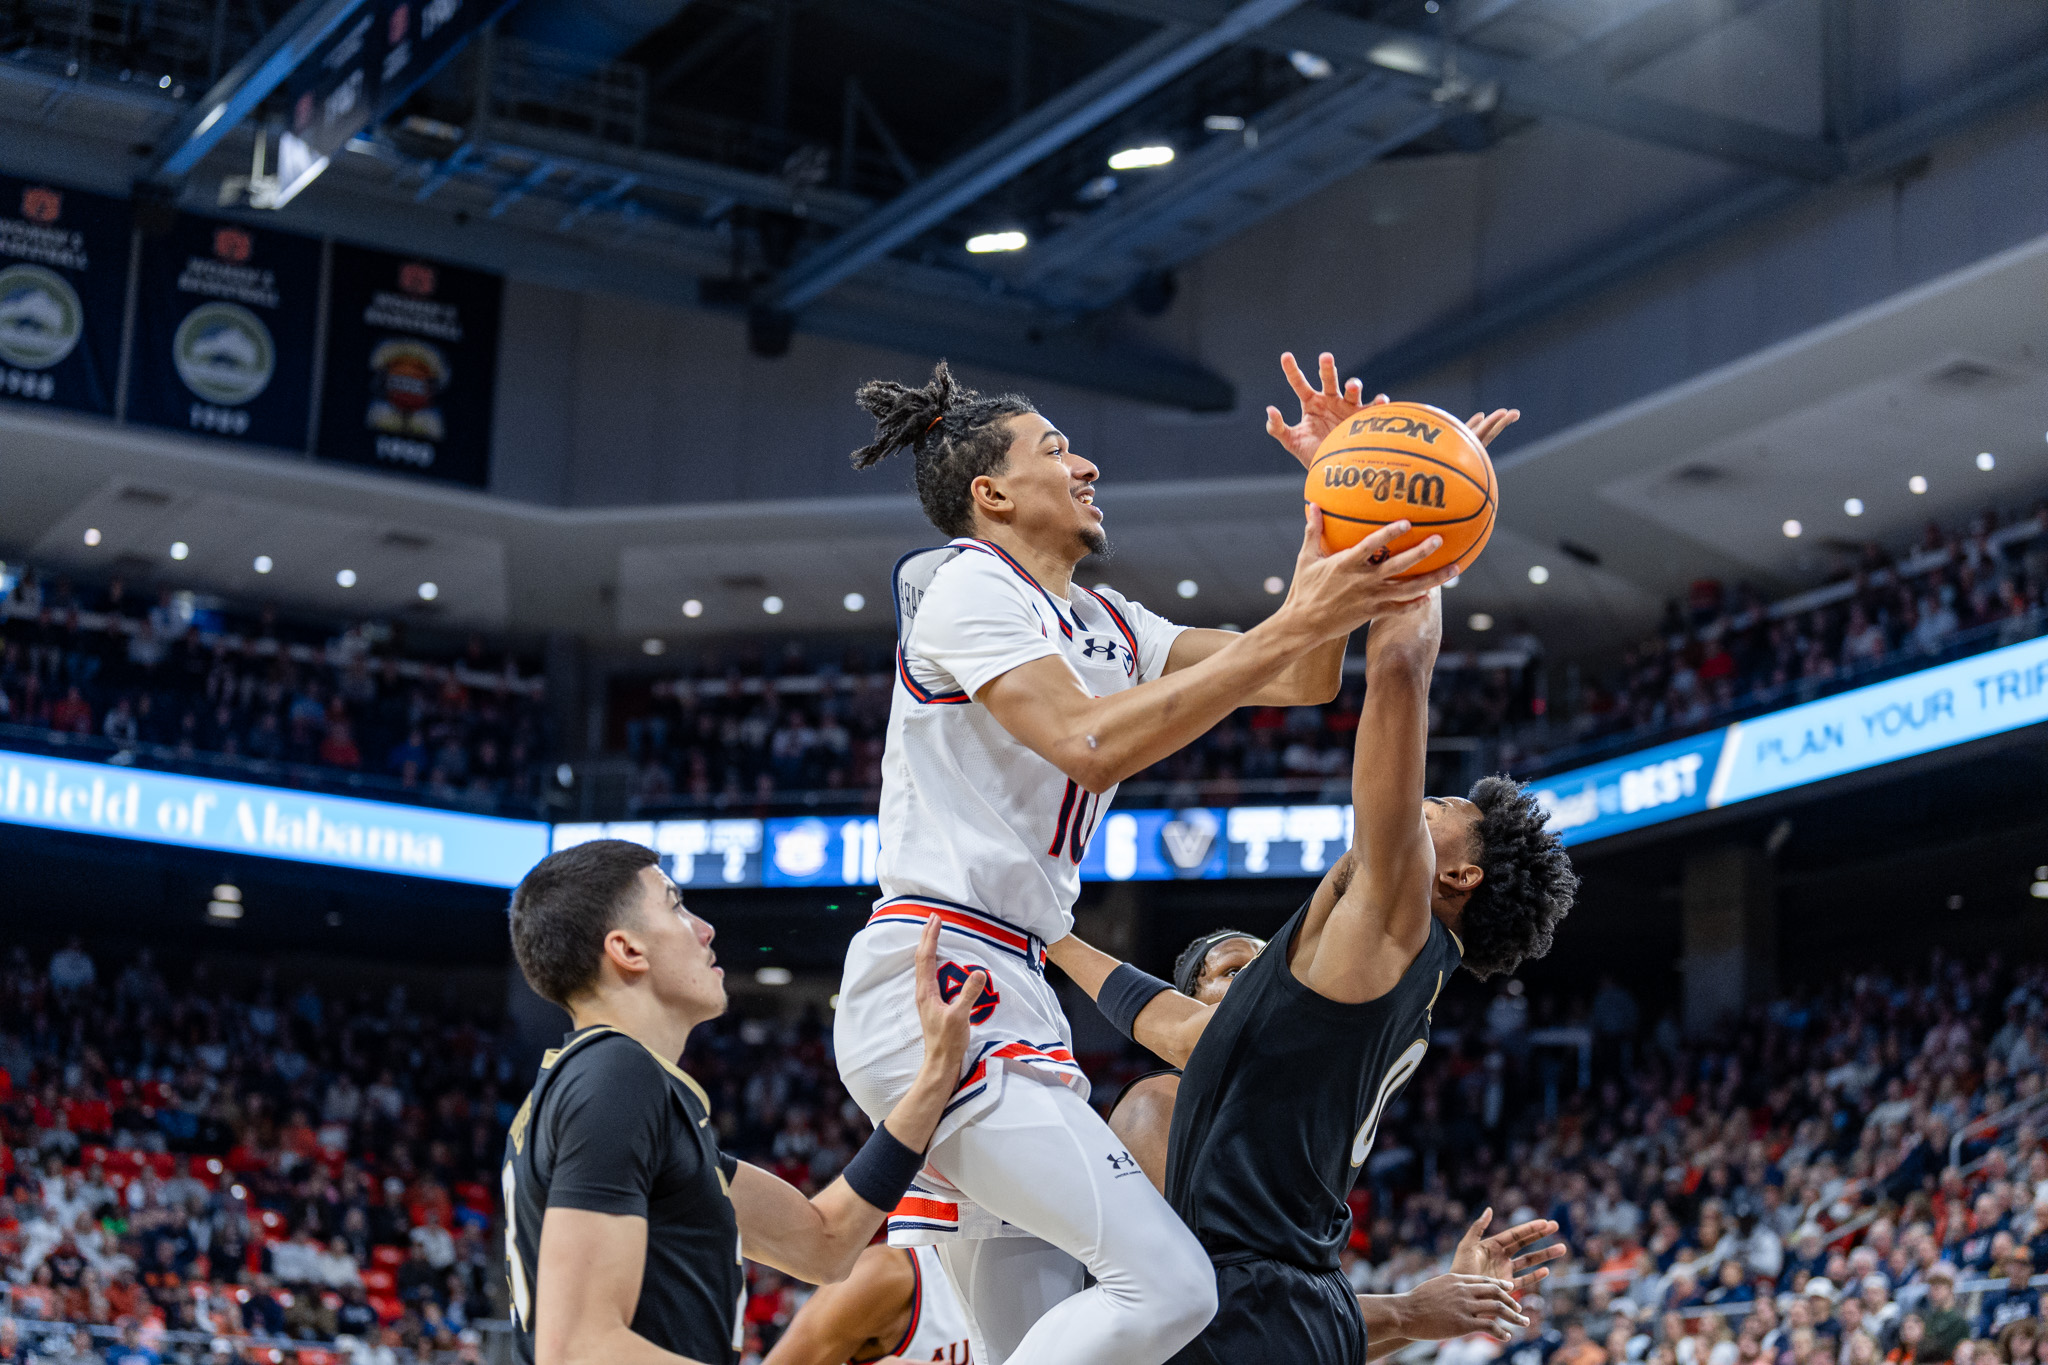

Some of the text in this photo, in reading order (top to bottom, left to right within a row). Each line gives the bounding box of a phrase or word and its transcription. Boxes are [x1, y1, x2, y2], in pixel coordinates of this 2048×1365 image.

[1348, 416, 1443, 445] NCAA
[1324, 465, 1447, 509] Wilson
[1756, 721, 1845, 767] PLAN
[1861, 687, 1956, 738] YOUR
[0, 765, 444, 868] hield of Alabama
[1048, 777, 1100, 866] 10
[1620, 752, 1704, 815] BEST
[1351, 1038, 1429, 1167] 0
